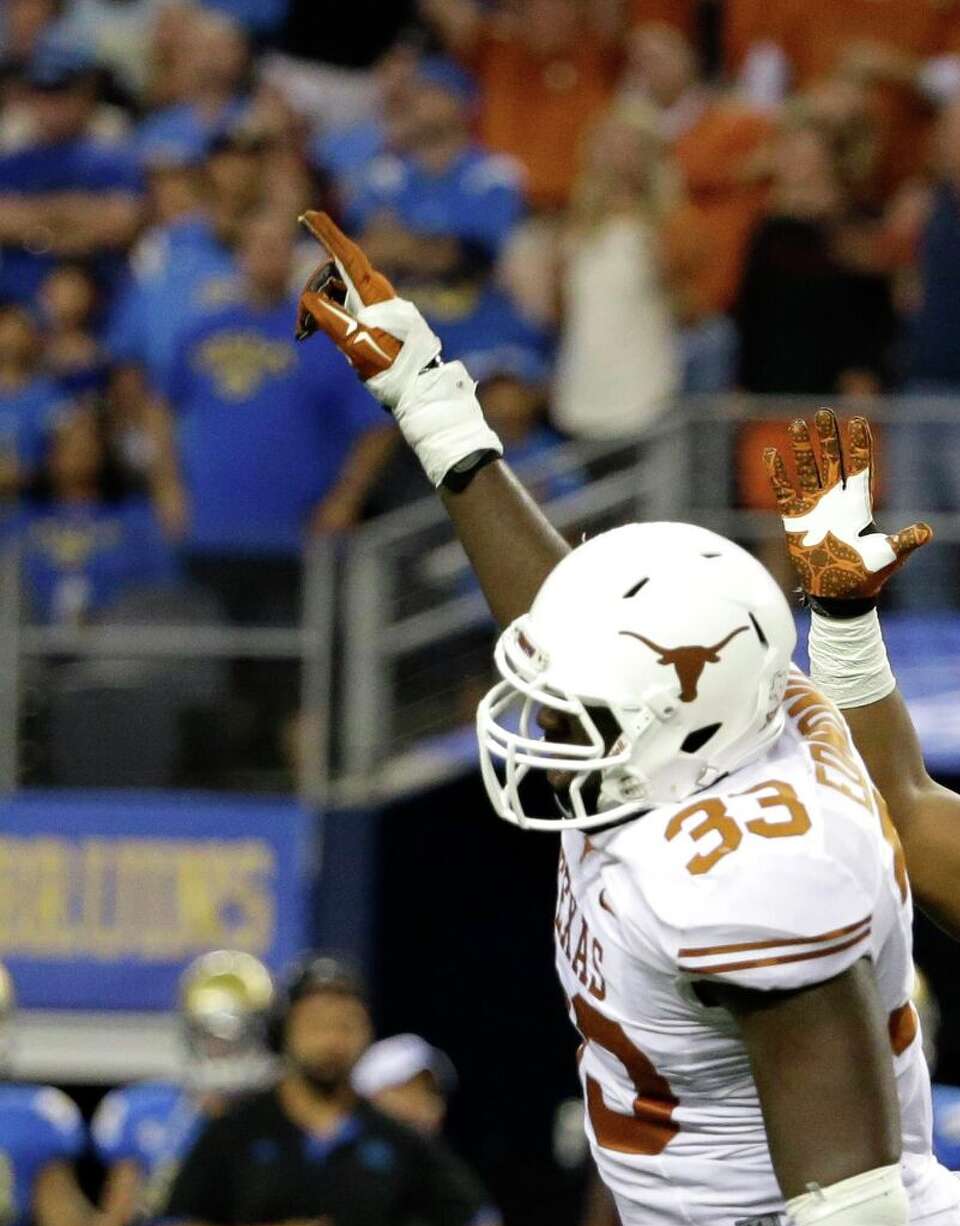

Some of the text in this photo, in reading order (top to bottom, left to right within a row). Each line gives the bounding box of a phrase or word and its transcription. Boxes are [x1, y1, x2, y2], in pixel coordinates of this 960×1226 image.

[663, 779, 812, 876] 33
[555, 848, 606, 1001] EXAS
[568, 993, 681, 1156] 3
